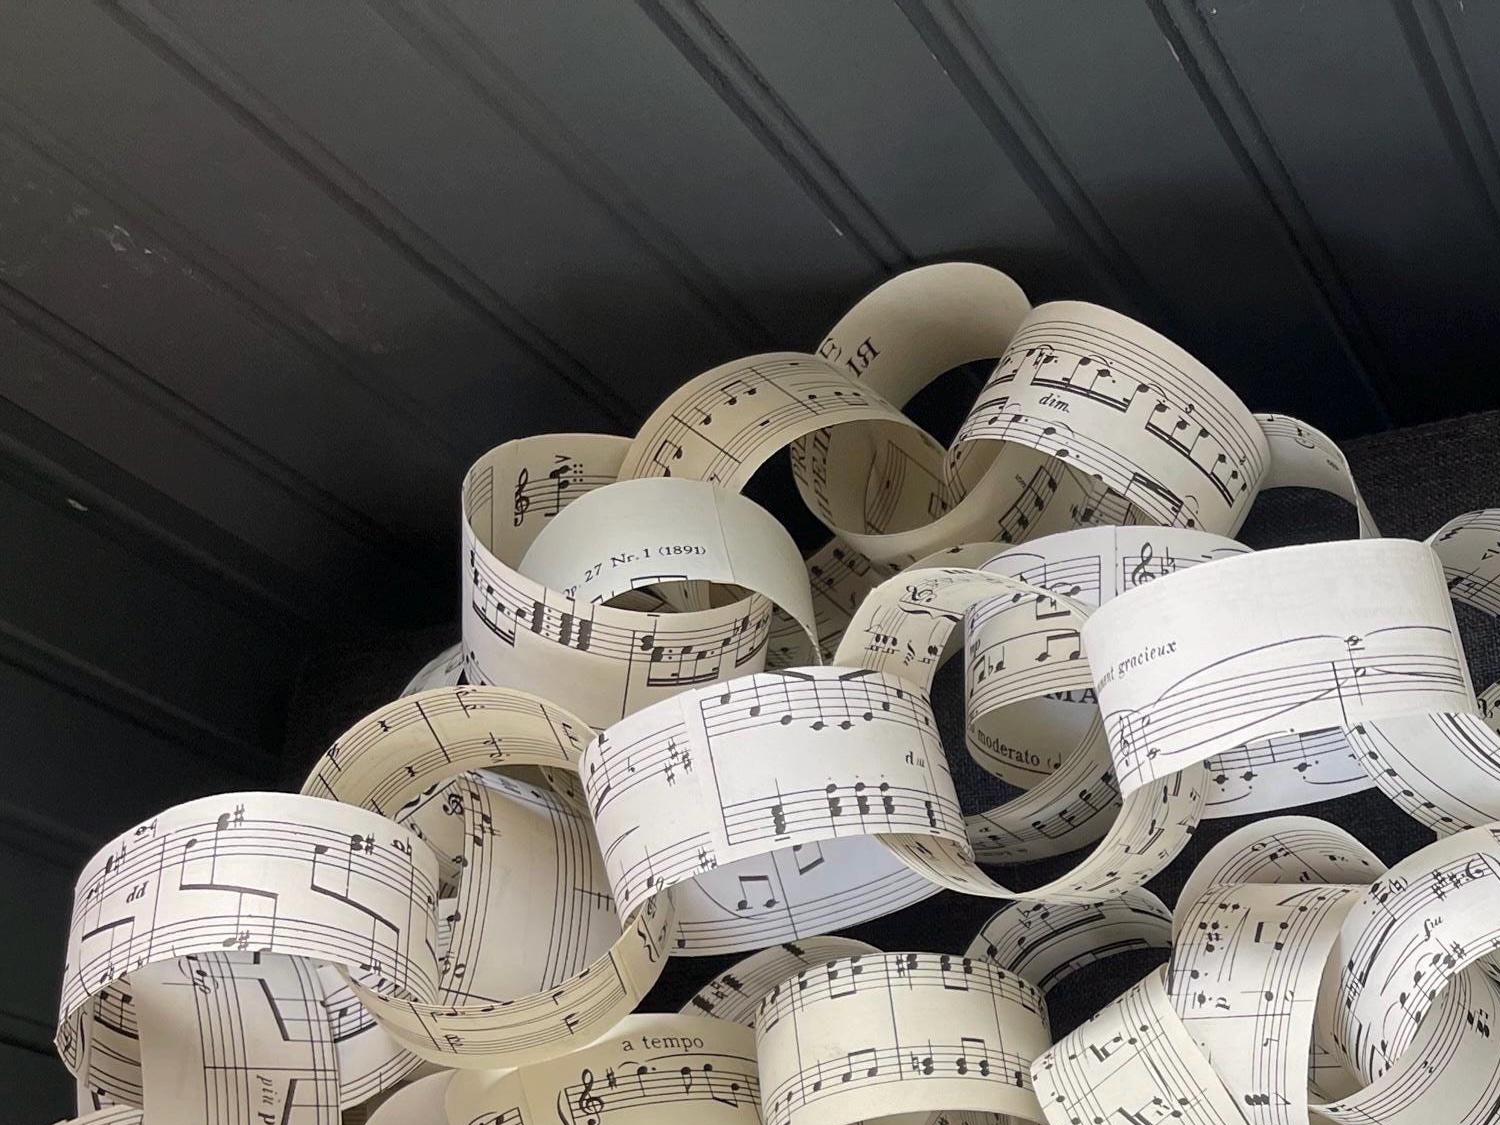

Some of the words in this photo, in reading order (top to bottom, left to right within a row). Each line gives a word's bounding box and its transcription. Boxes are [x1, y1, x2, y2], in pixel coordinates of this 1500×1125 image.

[585, 563, 602, 583] 27
[611, 553, 639, 568] Nr.
[643, 549, 651, 558] 1
[658, 545, 707, 556] (1891)
[1117, 640, 1177, 680] gracieux
[977, 728, 1041, 768] moderato
[621, 1039, 634, 1052] a
[642, 1035, 704, 1052] tempo
